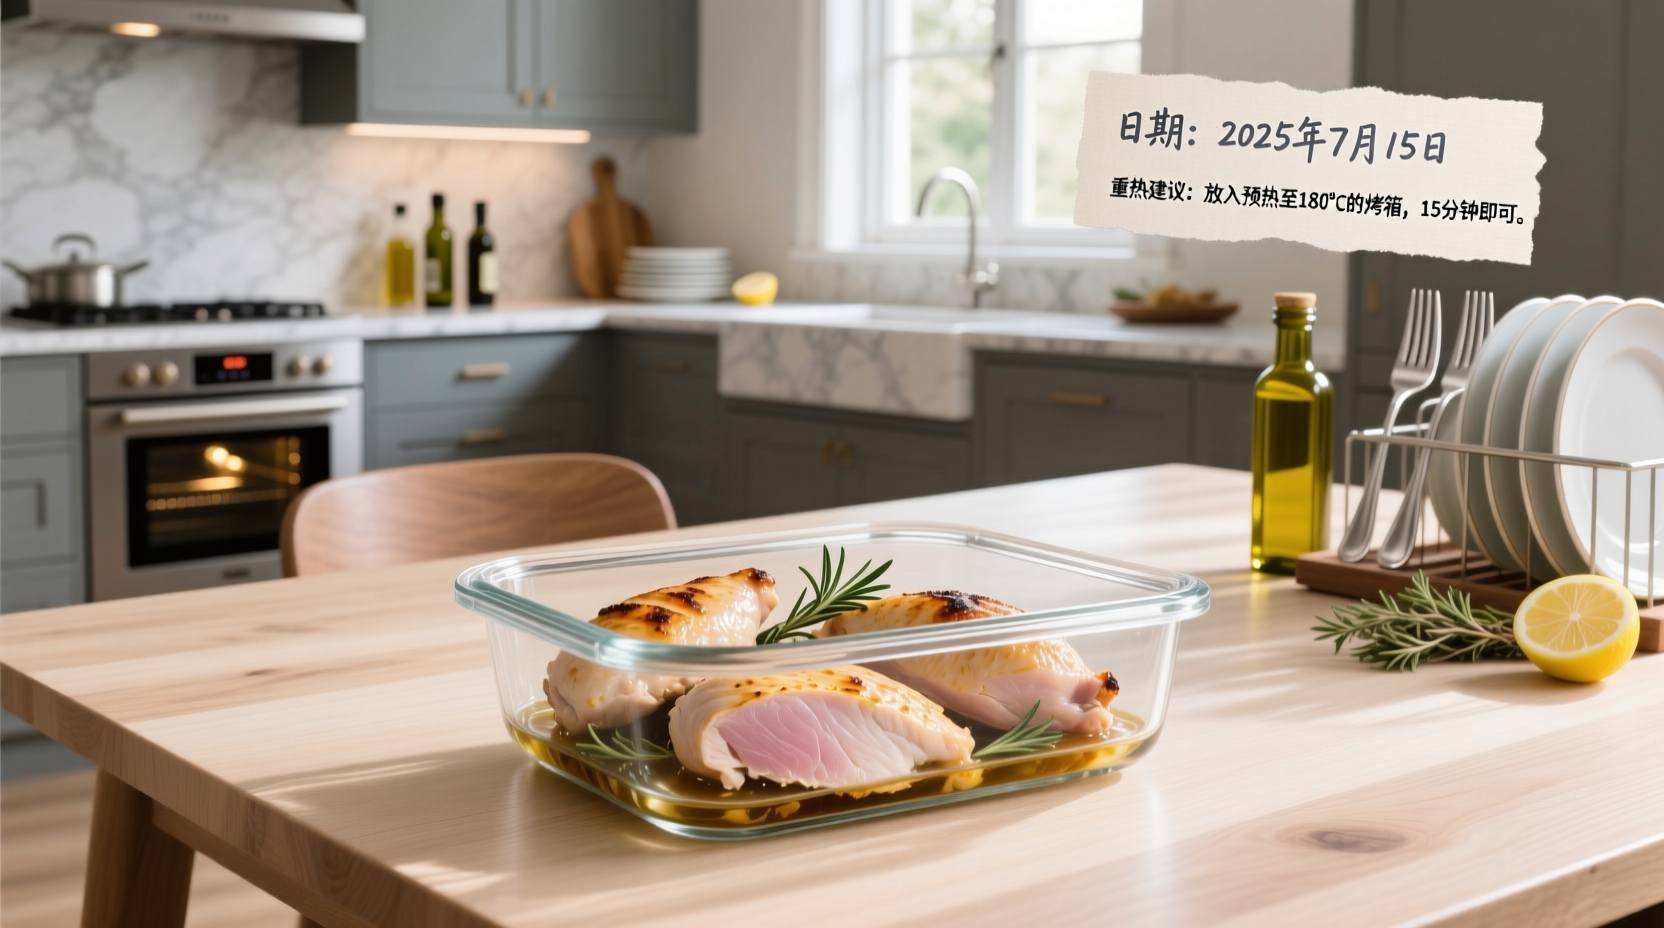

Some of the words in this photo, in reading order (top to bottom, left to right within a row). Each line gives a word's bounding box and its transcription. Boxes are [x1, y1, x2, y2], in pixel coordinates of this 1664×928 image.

[1119, 107, 1447, 164] 日期：2025年7月15日
